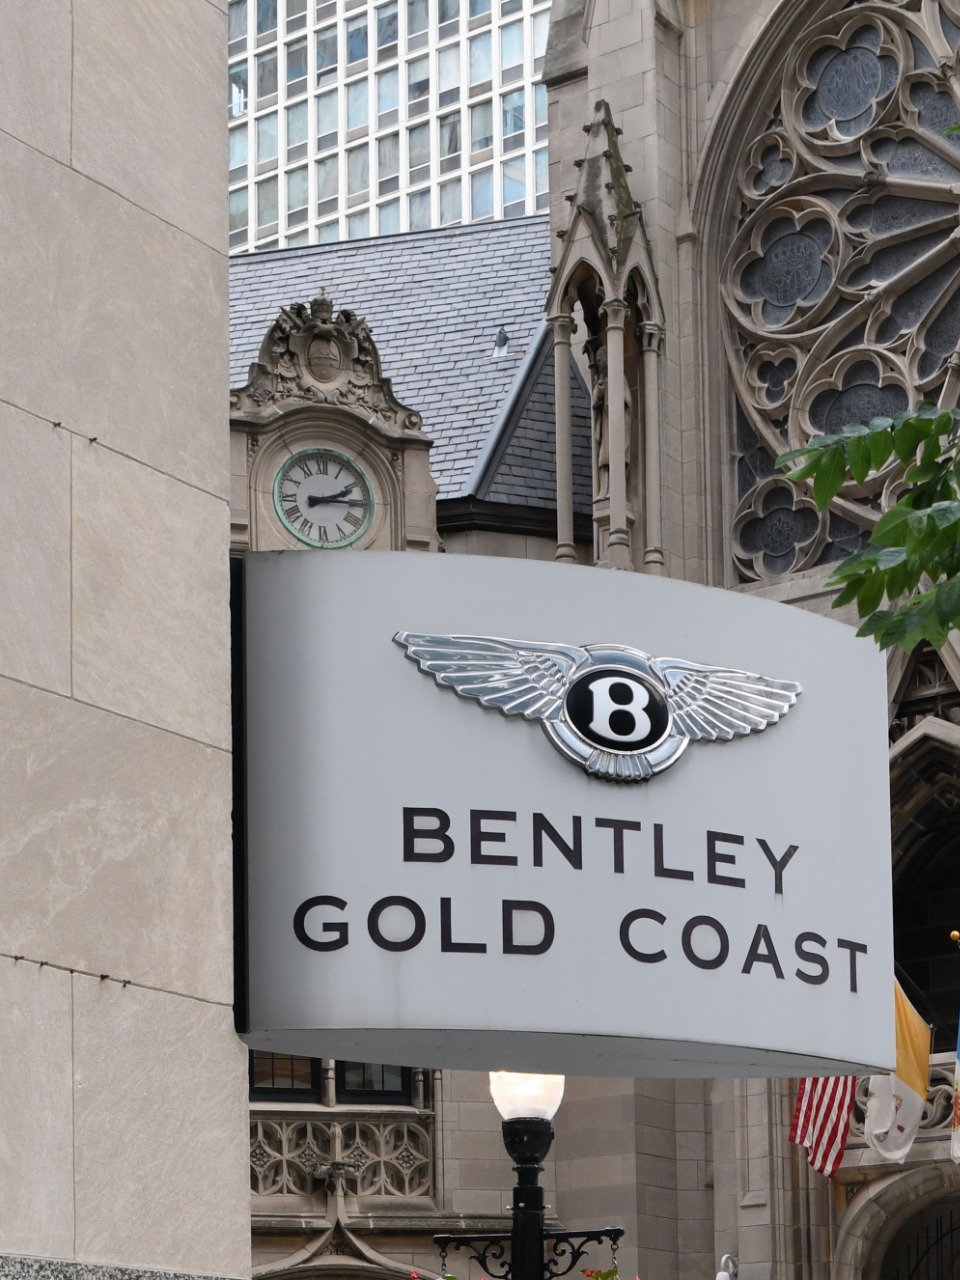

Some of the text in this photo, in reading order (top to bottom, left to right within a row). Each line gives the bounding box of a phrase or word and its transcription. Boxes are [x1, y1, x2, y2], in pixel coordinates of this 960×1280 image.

[588, 676, 651, 742] B
[402, 806, 799, 895] BENTLEY
[292, 894, 868, 993] GOLD COAST
